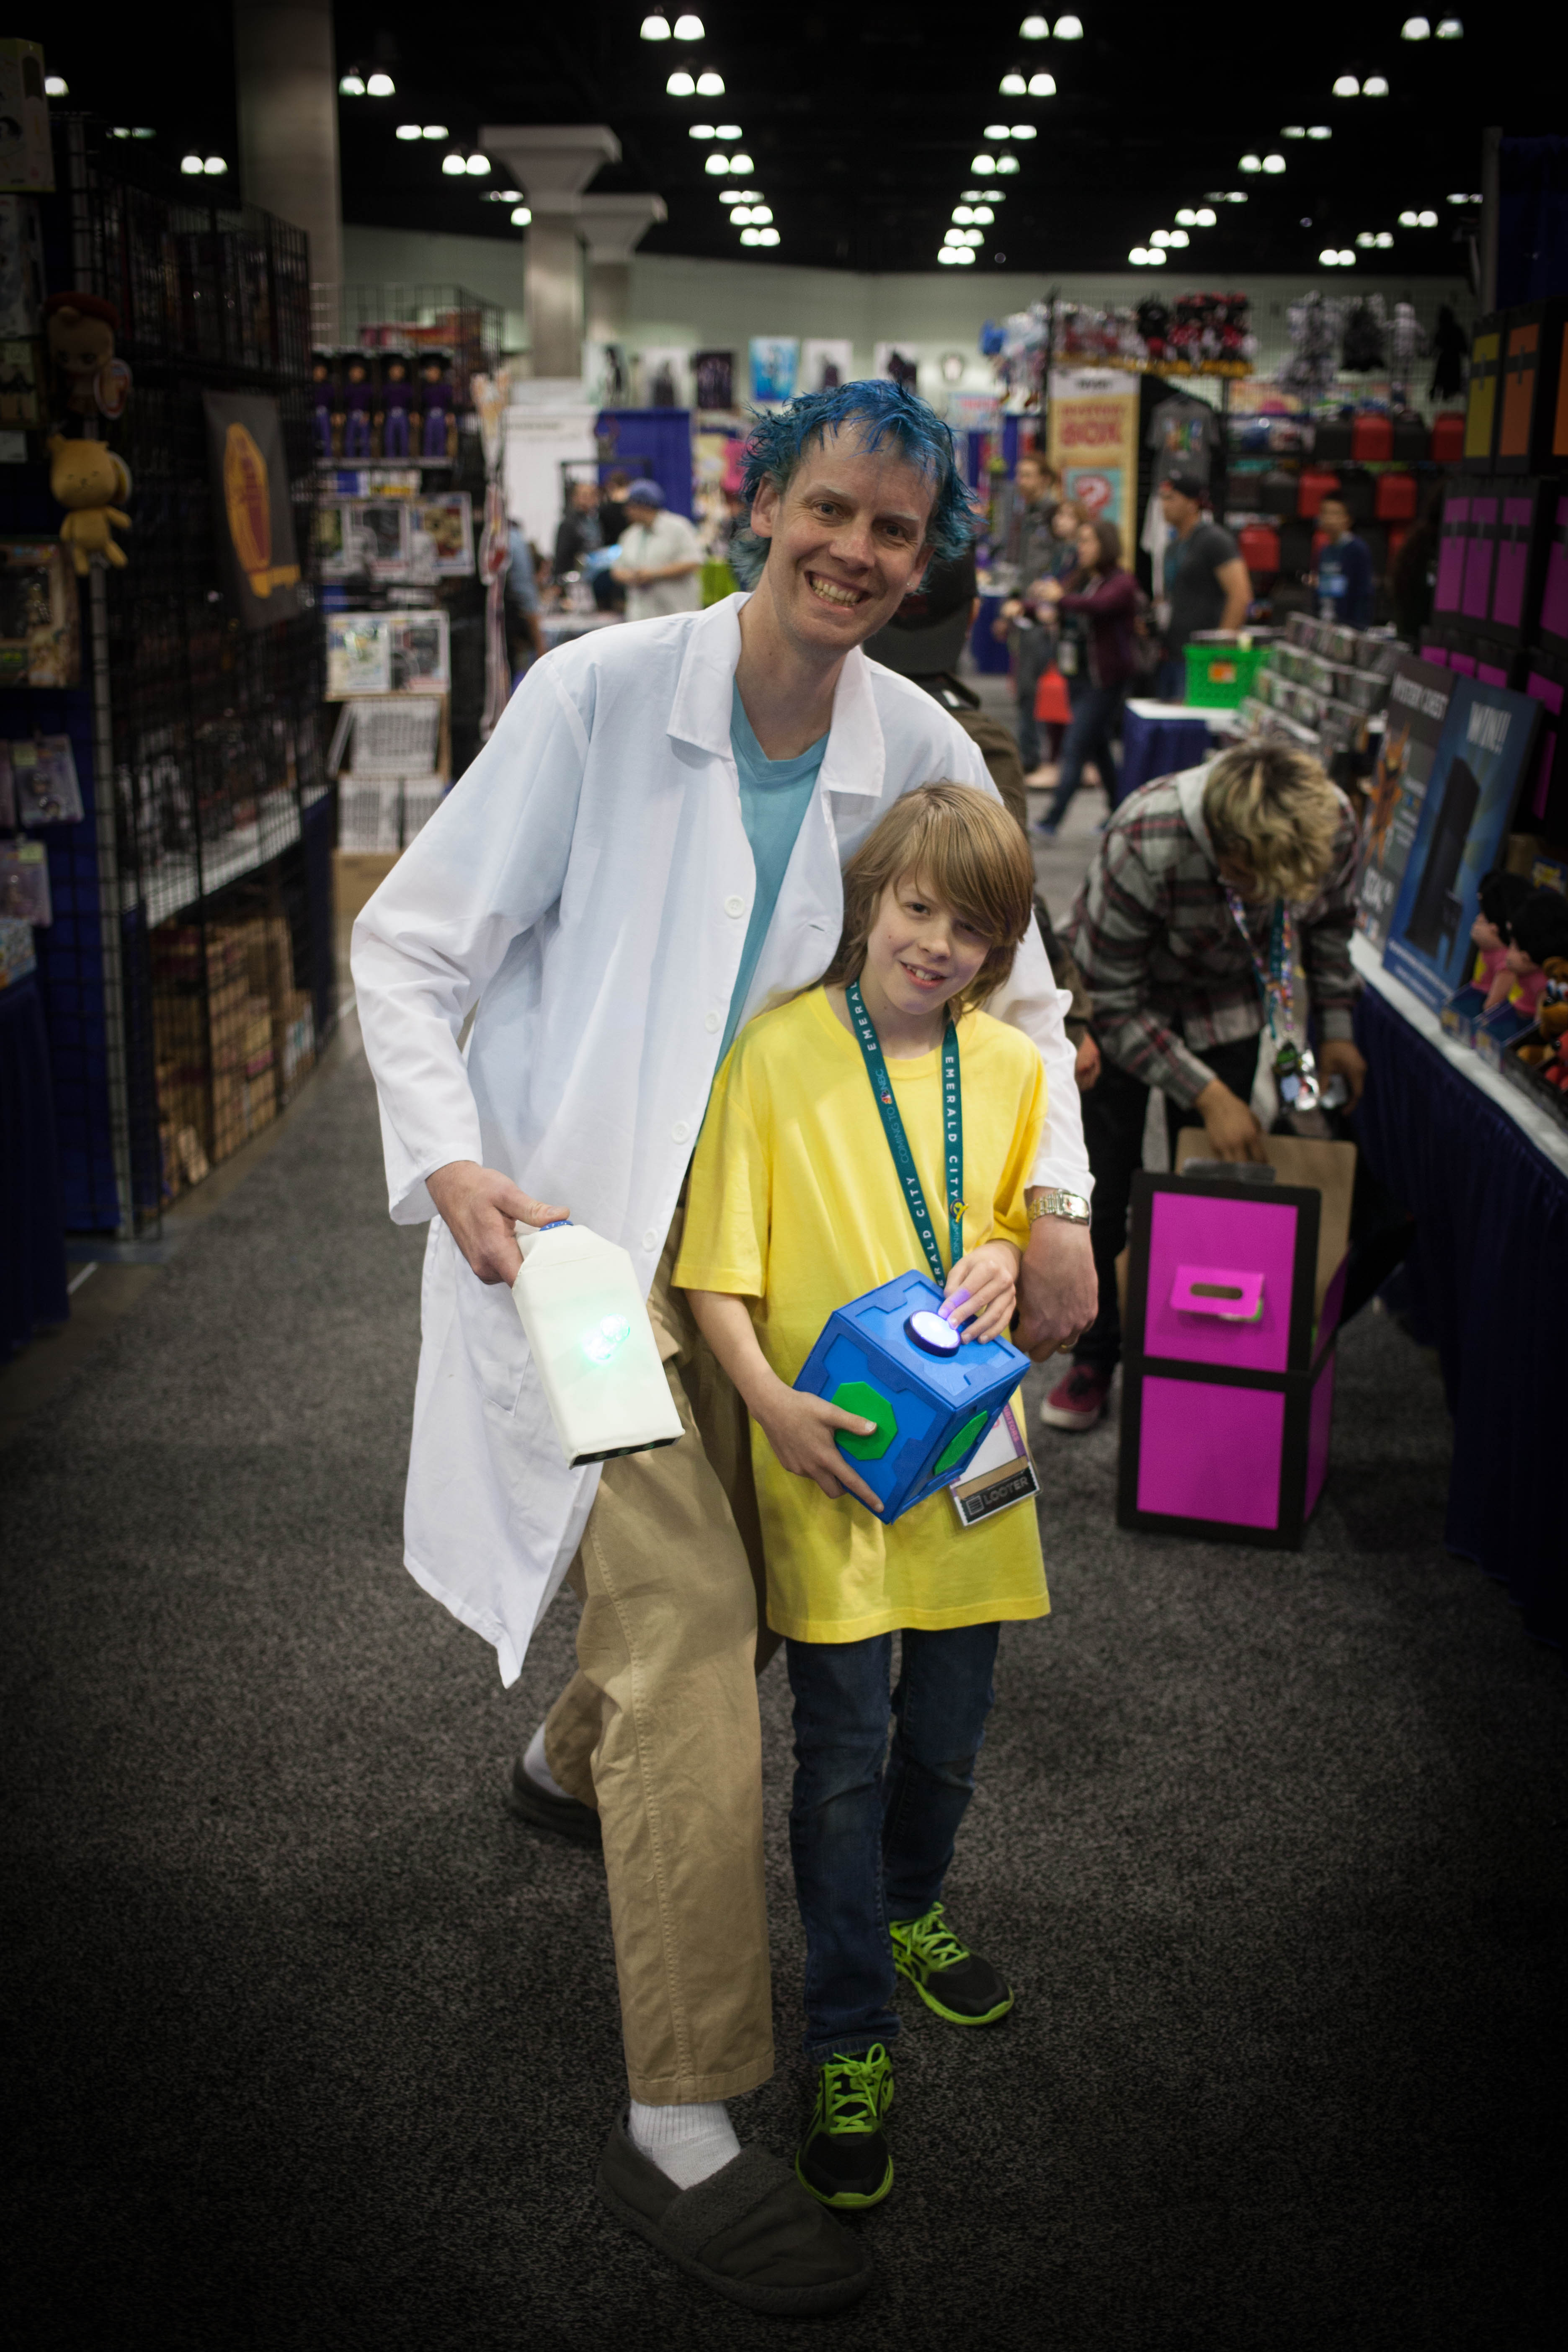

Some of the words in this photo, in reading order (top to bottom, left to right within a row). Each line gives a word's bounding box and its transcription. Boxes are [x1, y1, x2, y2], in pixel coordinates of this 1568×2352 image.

[851, 981, 877, 1051] EMERAL
[875, 1068, 888, 1091] NBC
[945, 1056, 957, 1142] EMERALD
[886, 1107, 897, 1121] TO
[891, 1122, 909, 1163] COMING
[949, 1155, 958, 1197] CITY
[906, 1177, 925, 1217] CITY
[923, 1230, 944, 1287] ERALD
